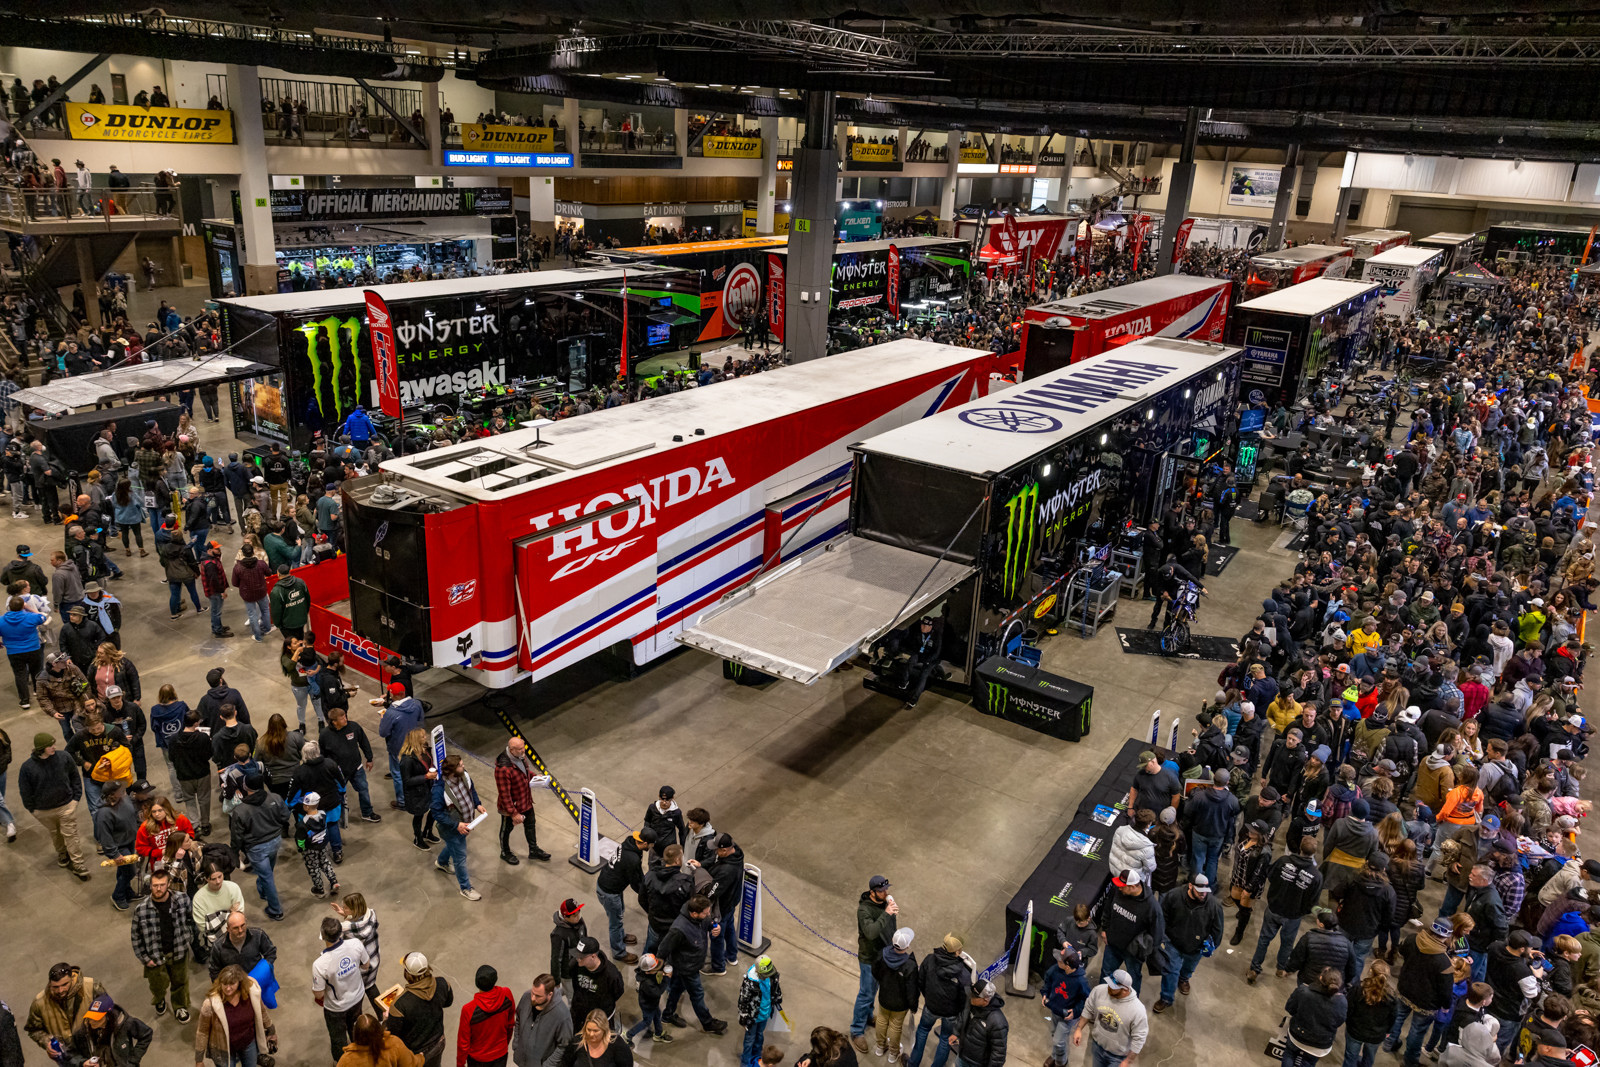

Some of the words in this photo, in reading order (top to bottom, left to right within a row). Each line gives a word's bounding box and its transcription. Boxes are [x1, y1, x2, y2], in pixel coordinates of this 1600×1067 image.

[105, 114, 221, 131] DUNLOP
[103, 128, 177, 139] MOTORCYCLE
[183, 131, 213, 140] TIRES
[481, 131, 548, 143] DUNLOP
[715, 141, 758, 151] DUNLOP
[861, 147, 891, 156] DUNLOP
[450, 153, 466, 162] BUD
[466, 154, 488, 164] LIGHT
[494, 155, 510, 164] BUD
[510, 155, 531, 164] LIGHT
[536, 156, 551, 165] BUD
[551, 156, 570, 165] LIGHT
[307, 194, 369, 215] OFFICIAL
[371, 193, 461, 214] MERCHANDISE
[555, 203, 584, 216] DRINK
[643, 205, 658, 216] EAT
[663, 205, 687, 216] DRINK
[797, 220, 807, 231] 8L
[836, 261, 887, 281] MONSTER
[843, 279, 880, 291] ENERGY
[1104, 316, 1153, 339] HONDA
[397, 342, 483, 364] ENERGY
[1257, 350, 1278, 359] YAMAHA
[1000, 359, 1179, 415] YAMAHA
[1038, 468, 1101, 526] MONSTER
[530, 456, 736, 562] HONDA
[1046, 501, 1091, 538] ENERGY
[549, 535, 645, 581] CRF
[1009, 695, 1061, 720] MONSTER
[1017, 706, 1053, 722] ENERGY
[1116, 904, 1137, 923] YAMAHA
